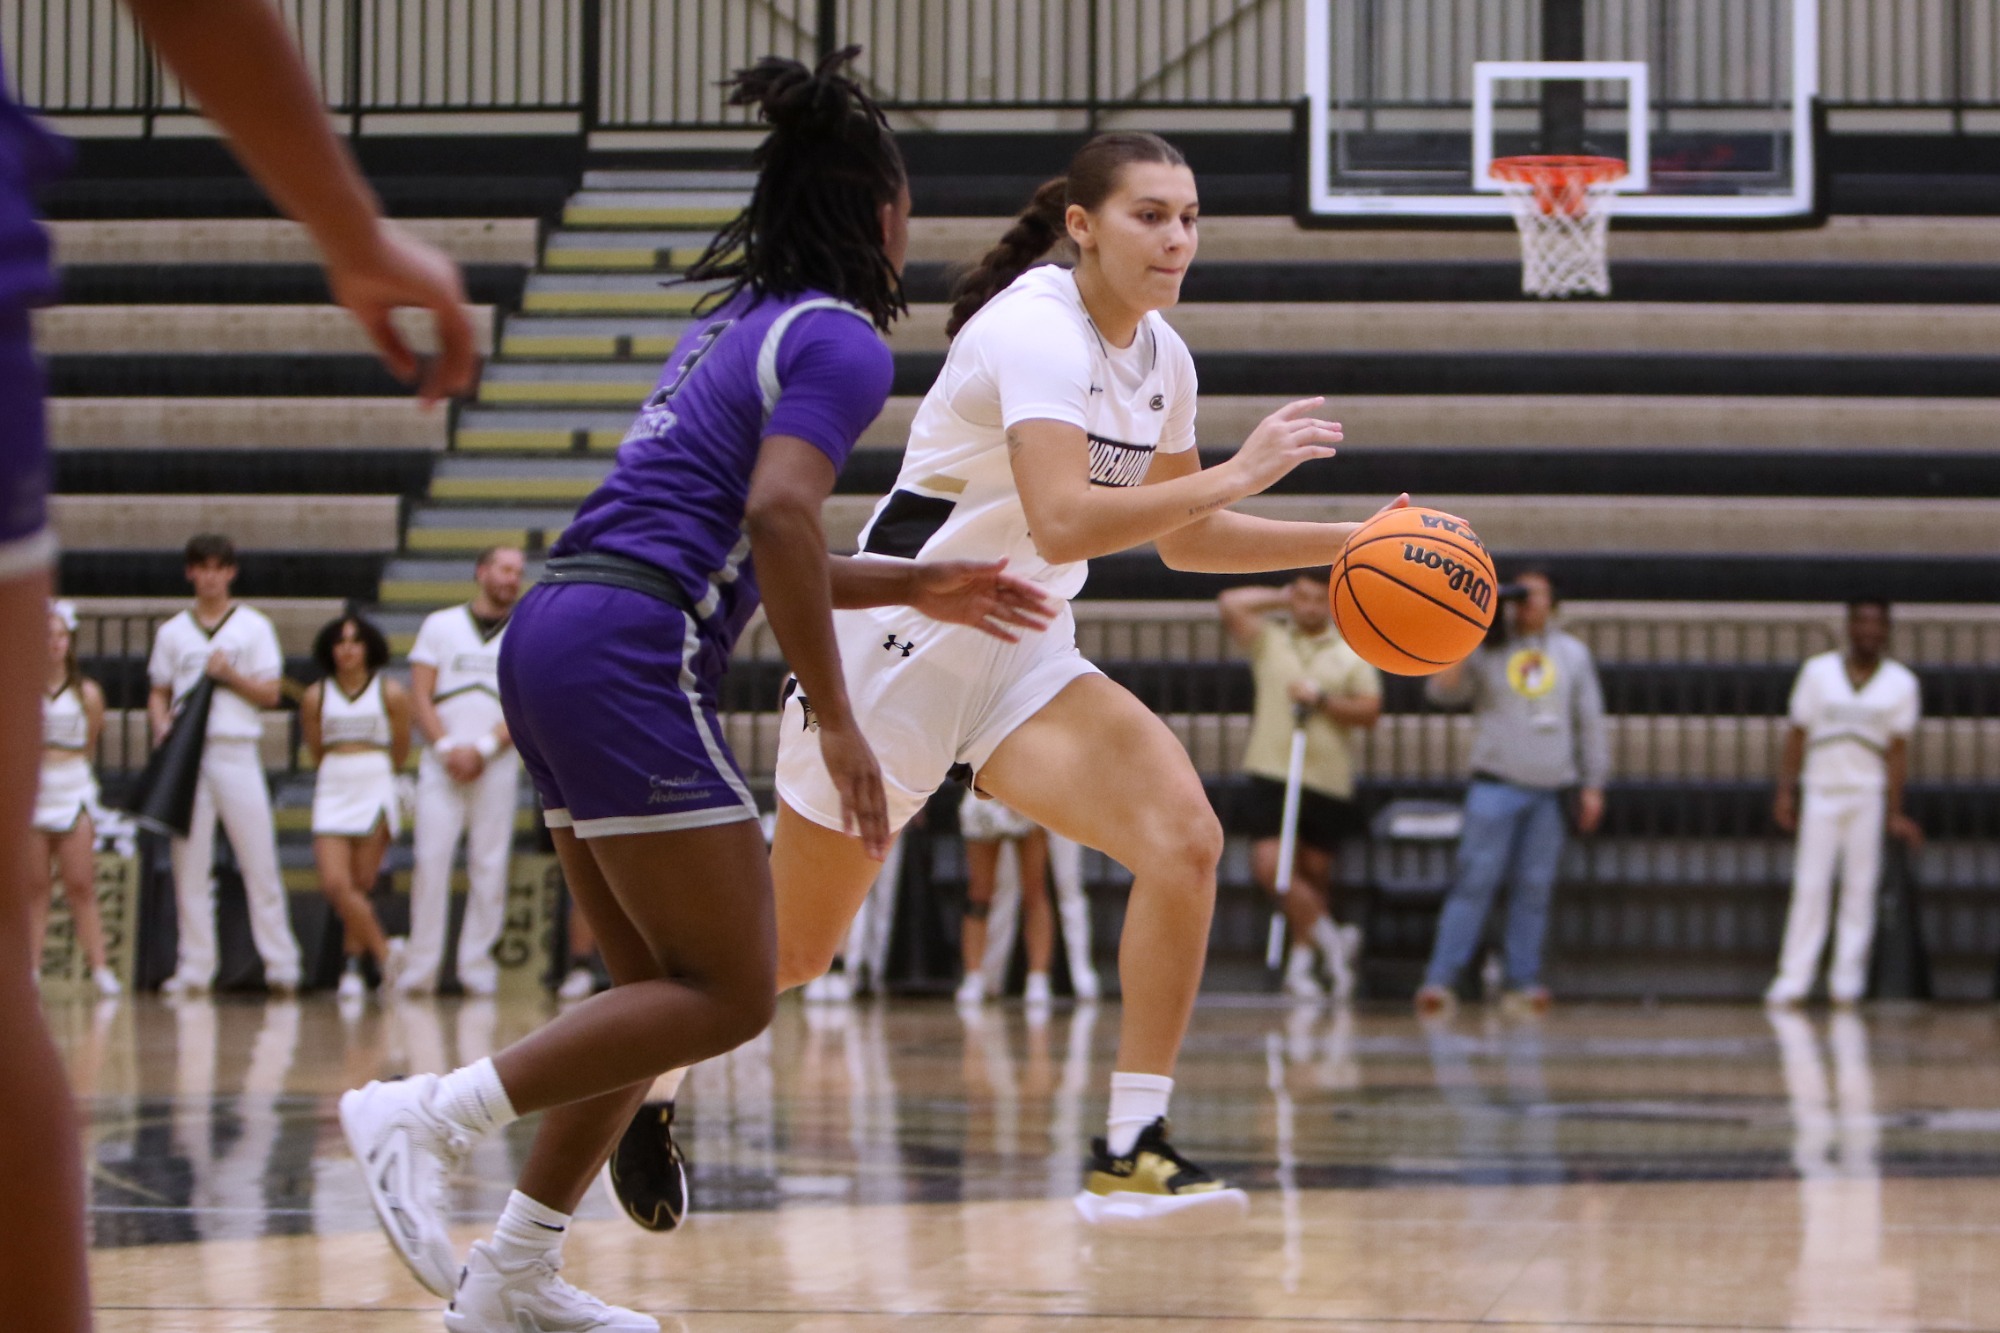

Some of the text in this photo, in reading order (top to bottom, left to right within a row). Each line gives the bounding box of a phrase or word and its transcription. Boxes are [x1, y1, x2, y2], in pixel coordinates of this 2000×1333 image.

[1403, 543, 1492, 614] Wilson
[649, 769, 700, 788] Central
[647, 789, 712, 805] Arkansas
